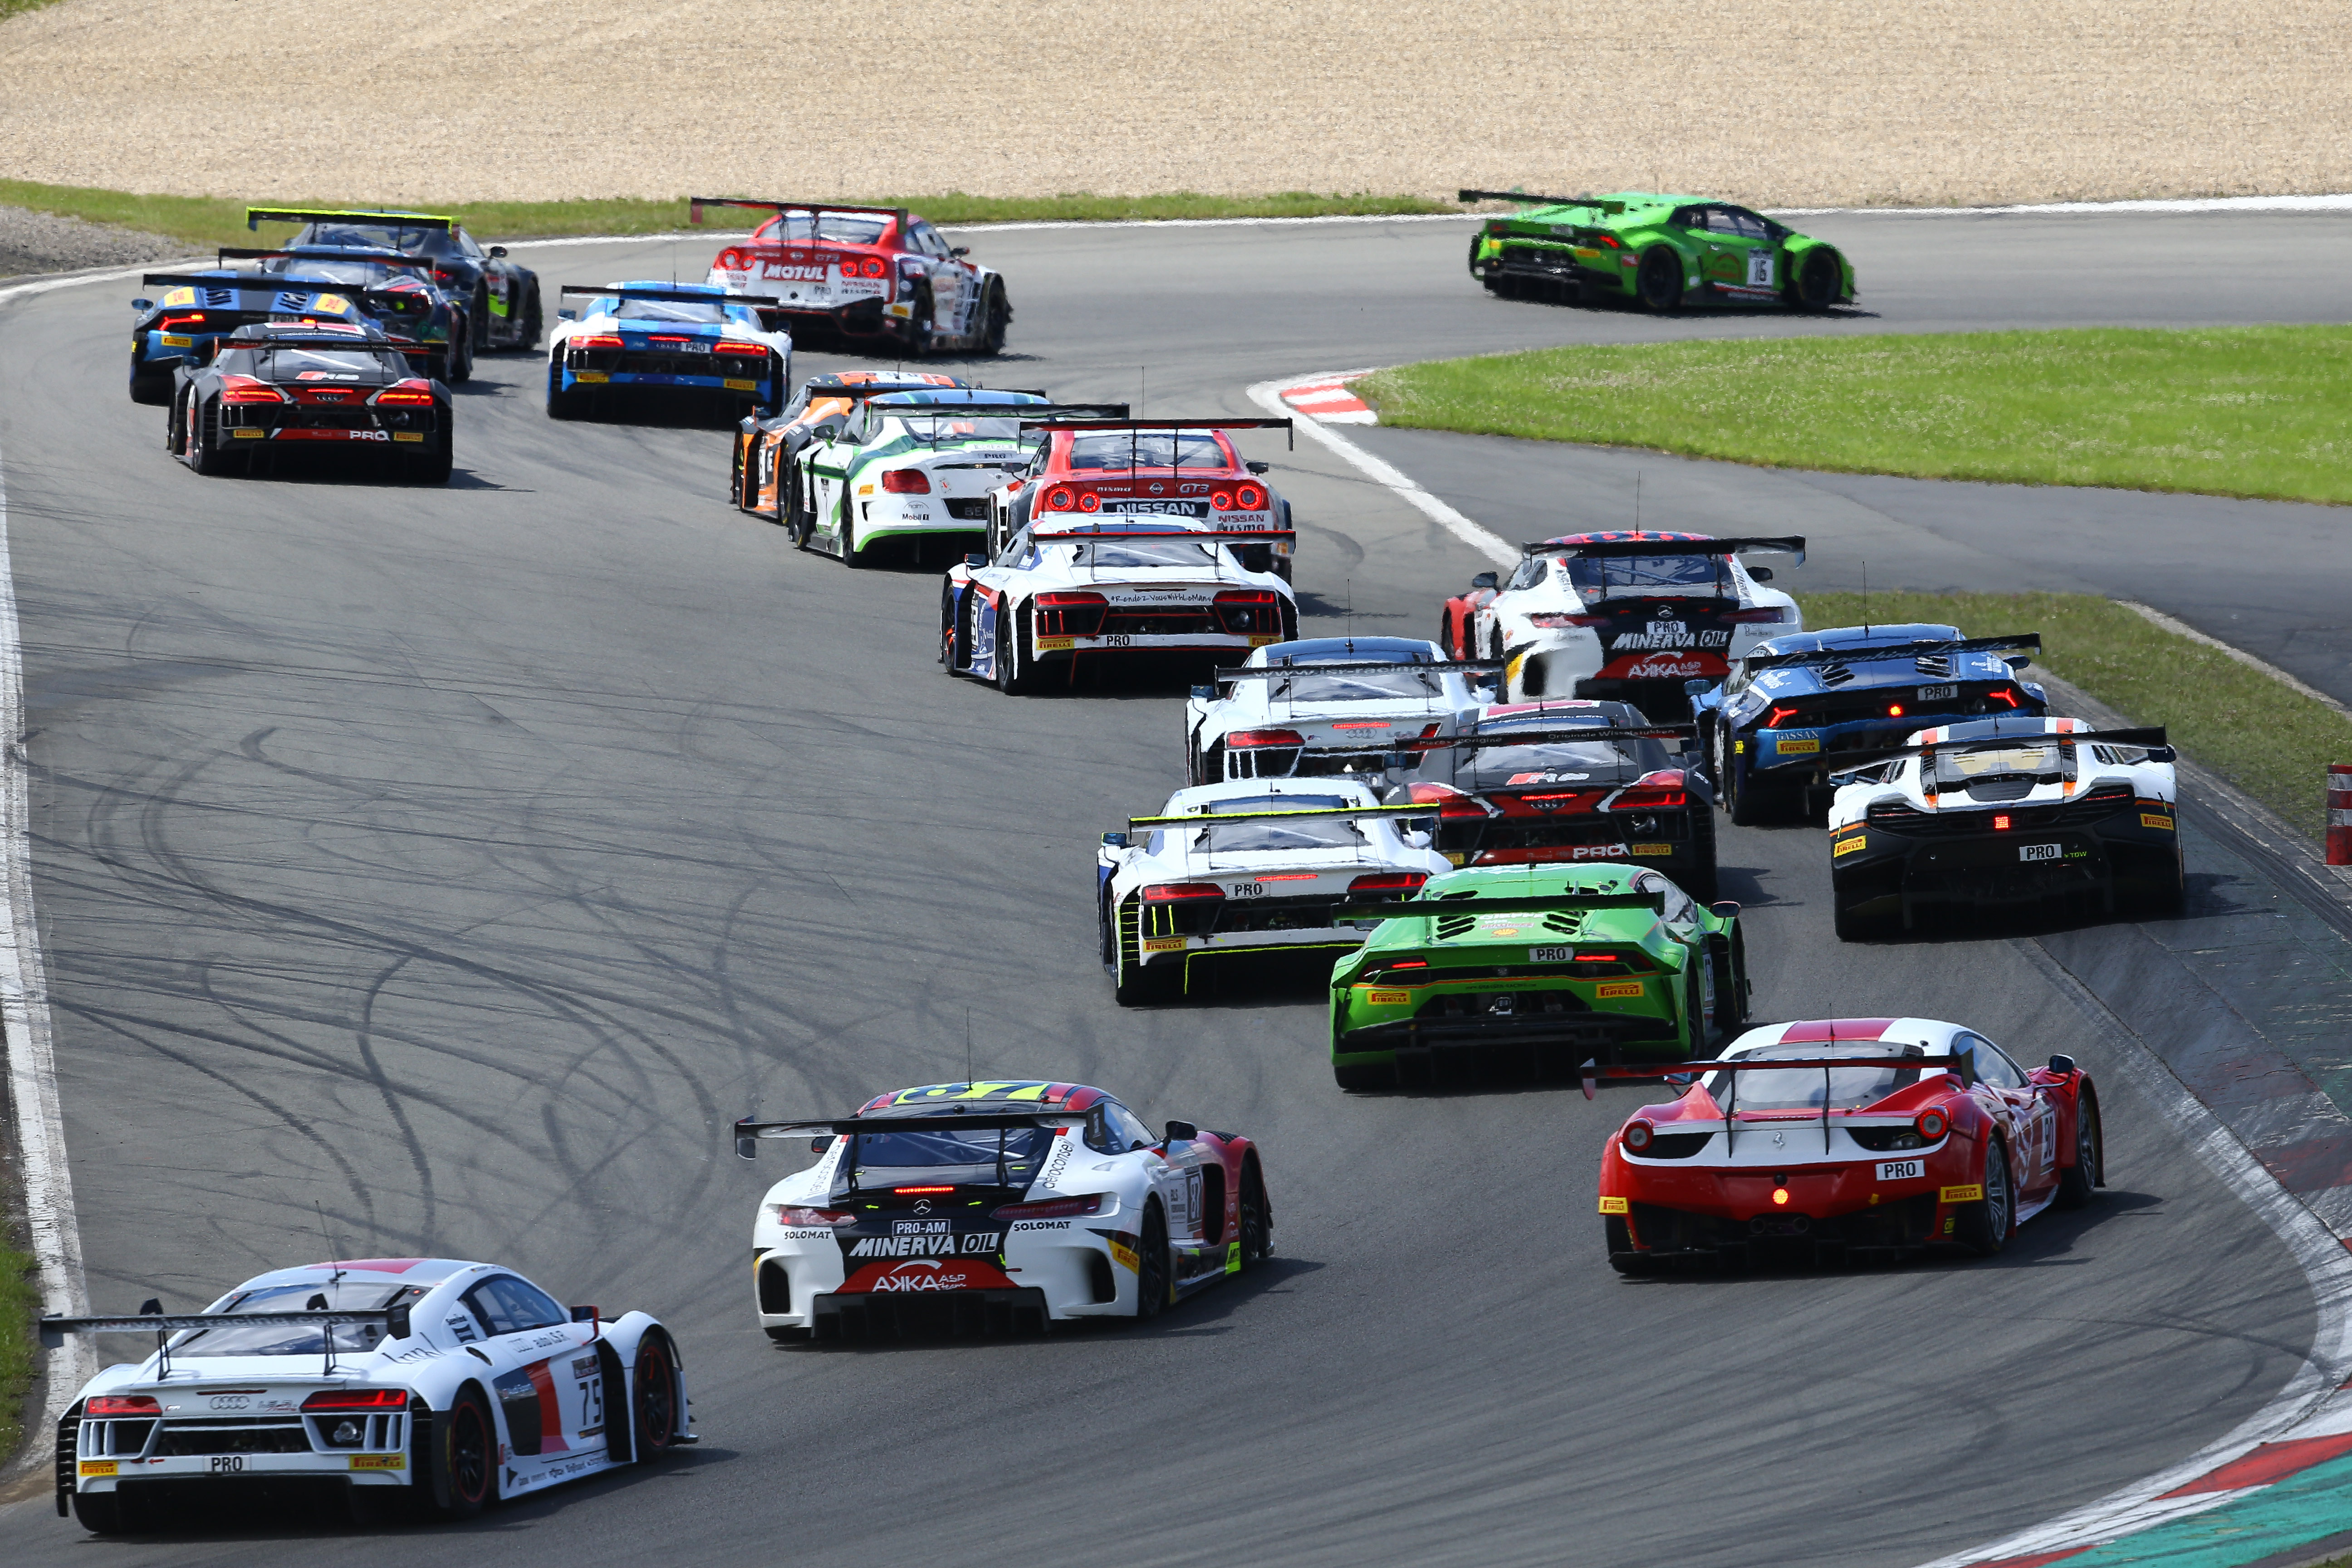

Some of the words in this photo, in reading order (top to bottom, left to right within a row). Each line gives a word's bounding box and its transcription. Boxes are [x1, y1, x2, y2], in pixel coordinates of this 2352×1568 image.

[764, 264, 825, 280] MOTUL
[1754, 260, 1767, 282] 16
[349, 430, 387, 440] PRO
[1179, 483, 1210, 494] GT3
[1116, 502, 1196, 515] NISSAN
[1218, 514, 1264, 522] NISSAN
[1654, 621, 1679, 633] PRO
[1039, 639, 1071, 649] PIRELLI
[1106, 635, 1131, 647] PRO
[1610, 632, 1695, 650] MINERVA
[1699, 630, 1728, 647] OIL
[1628, 663, 1681, 678] AKKA
[1925, 687, 1951, 699] PRO
[1776, 730, 1819, 740] GASSAN
[2139, 816, 2172, 828] PIRELLI
[1837, 838, 1862, 853] PIRELLI
[2026, 845, 2055, 860] PRO
[1234, 883, 1263, 897] PRO
[1146, 939, 1182, 950] PIRELLI
[1536, 948, 1567, 961] PRO
[1600, 984, 1640, 996] PIRELLI
[1372, 992, 1407, 1003] PIRELLI
[1042, 1136, 1076, 1189] aeroconseil
[807, 1144, 840, 1196] aeroconseil
[1883, 1162, 1916, 1179] PRO
[1945, 1187, 1978, 1200] PIRELLI
[897, 1222, 946, 1234] PRO-AM
[1014, 1221, 1072, 1232] SOLOMAT
[784, 1231, 832, 1240] SOLOMAT
[848, 1235, 956, 1257] MINERVA
[961, 1233, 1000, 1253] OIL
[1117, 1248, 1138, 1269] PIRELLI
[872, 1275, 942, 1293] AKKA
[938, 1274, 967, 1283] ASP
[578, 1377, 603, 1426] 75
[81, 1462, 115, 1474] PIRELLI
[211, 1456, 243, 1472] PRO
[353, 1455, 402, 1469] PIRELLI
